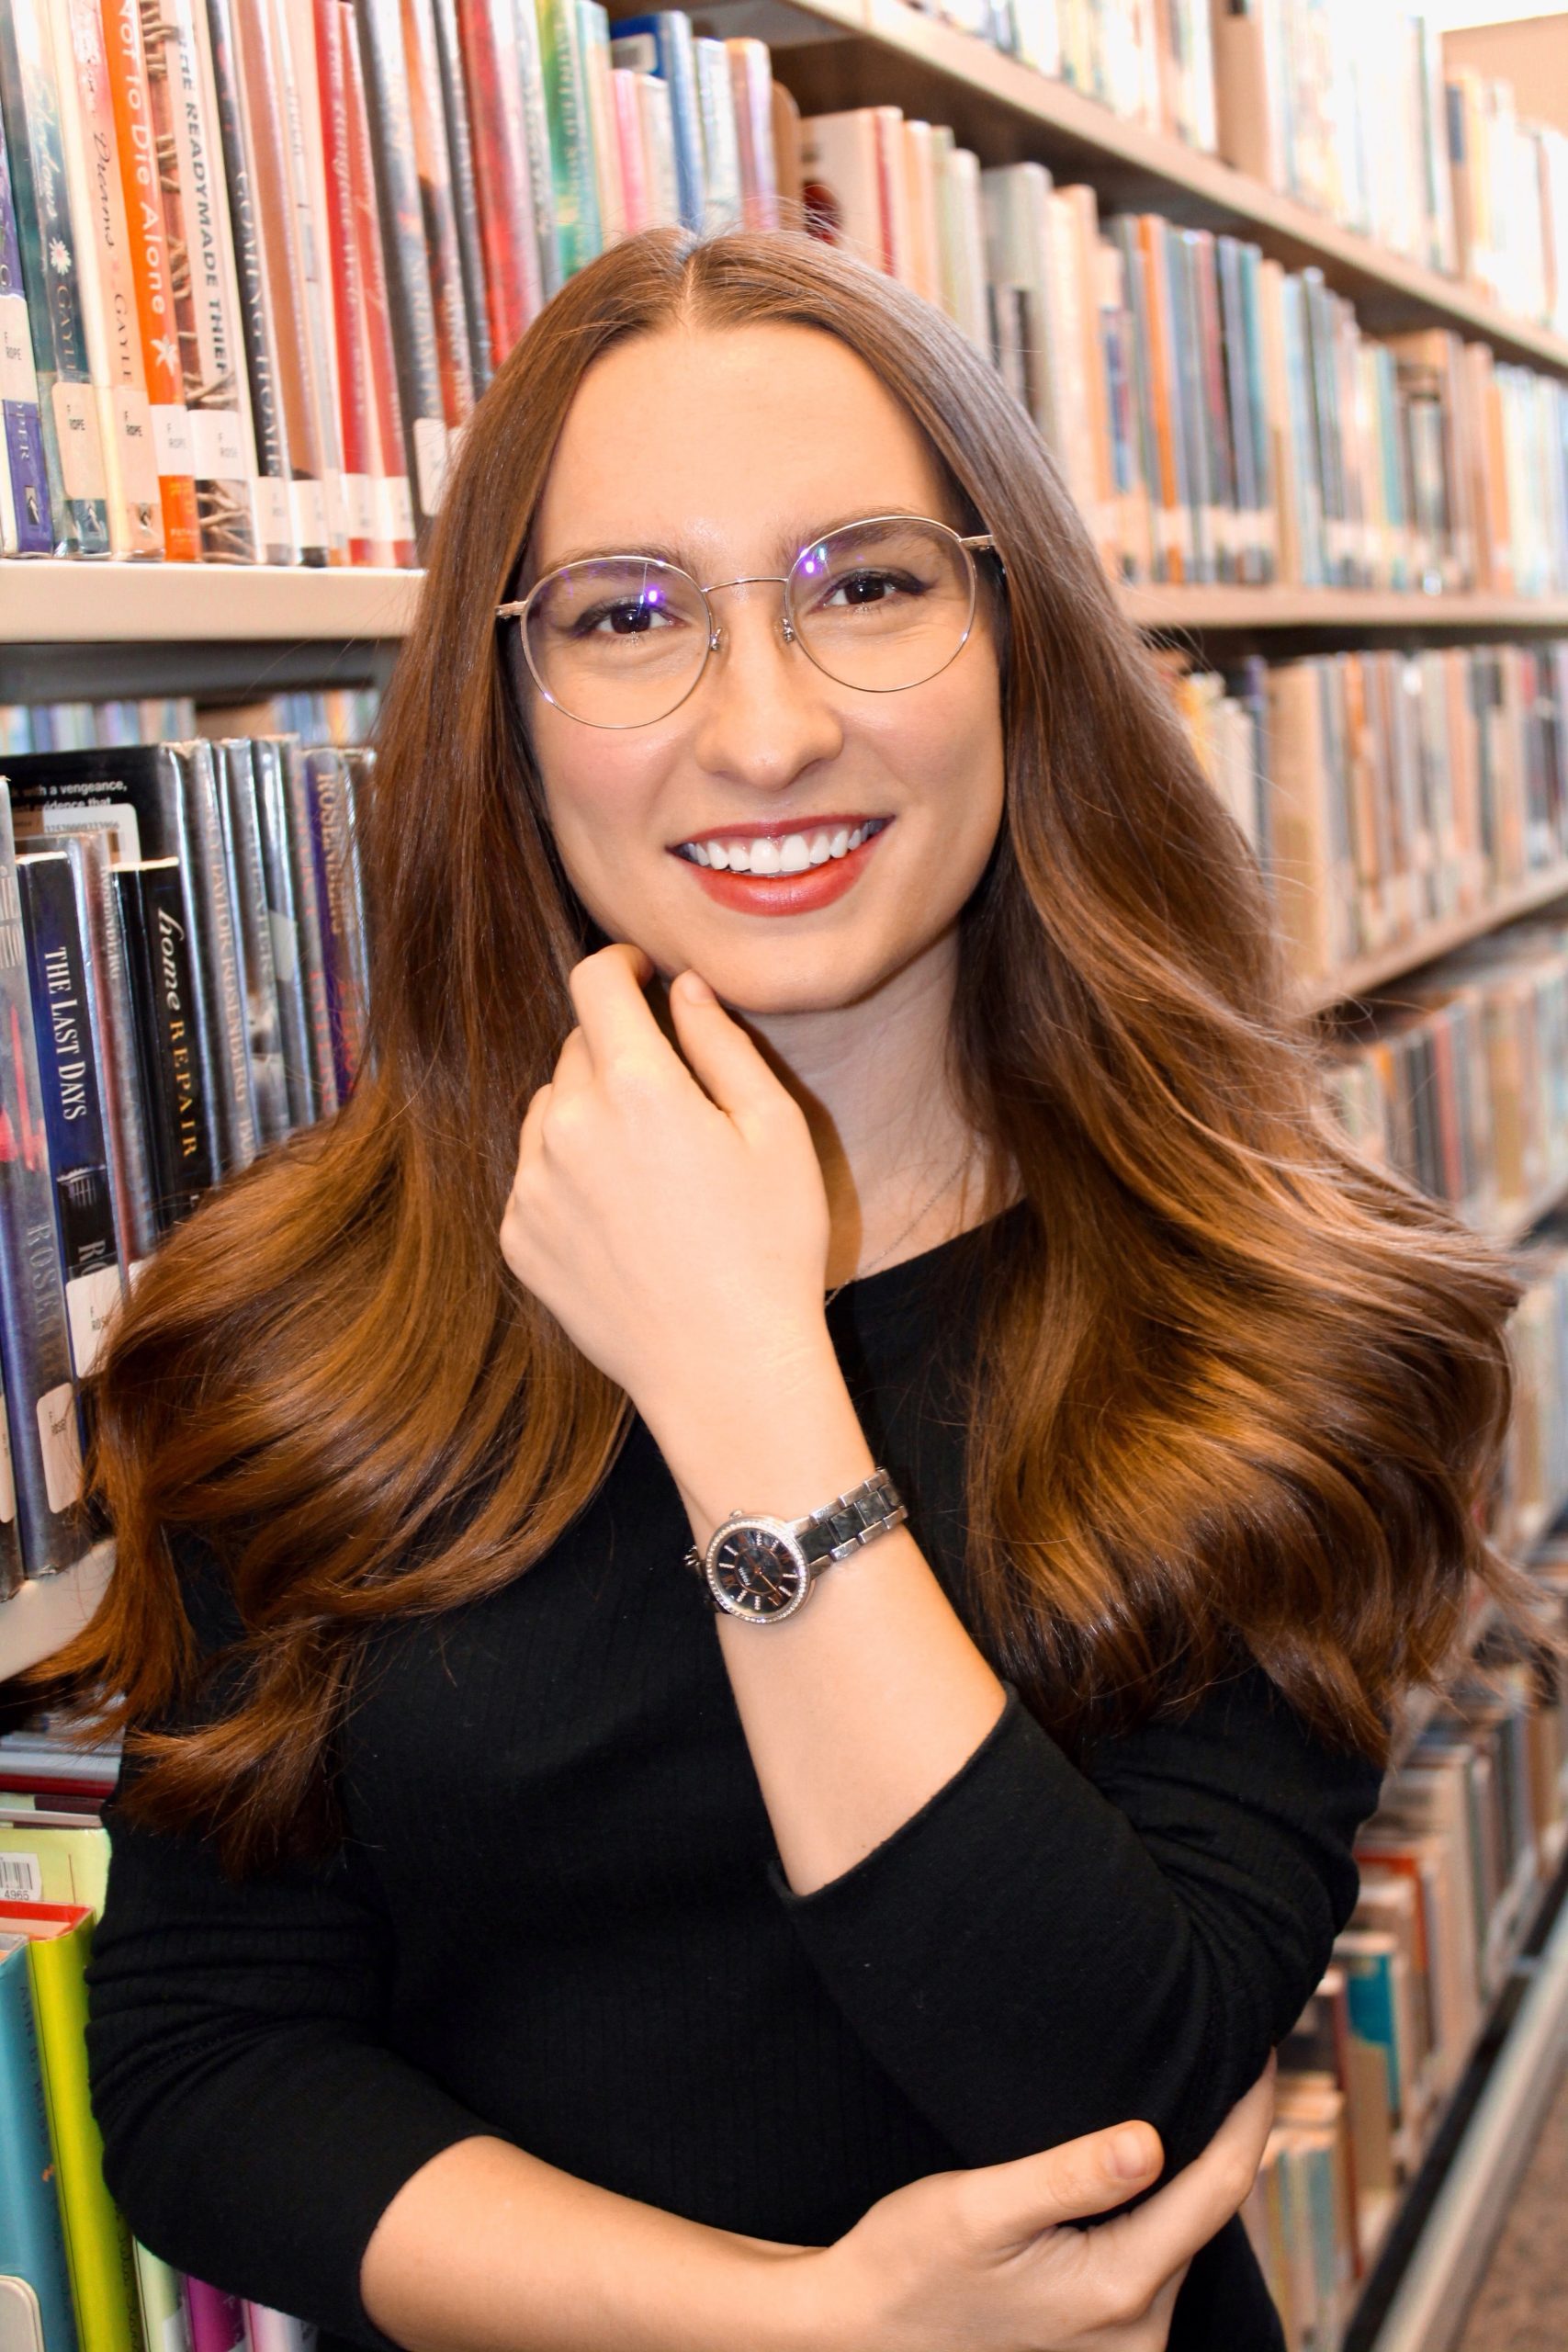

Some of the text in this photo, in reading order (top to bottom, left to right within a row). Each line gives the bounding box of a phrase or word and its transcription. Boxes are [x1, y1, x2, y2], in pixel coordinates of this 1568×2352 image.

[126, 74, 143, 109] to
[94, 131, 115, 247] Dreams
[131, 122, 154, 187] Die
[186, 102, 219, 288] READYMADE
[140, 200, 166, 315] Alone
[114, 293, 133, 383] GAYLE
[17, 401, 30, 460] PER
[50, 786, 57, 796] a
[60, 780, 128, 796] vengeance,
[211, 863, 232, 950] TAYLOR
[44, 946, 87, 1121] THE LAST DAYS
[158, 907, 198, 1157] home REPAIR
[221, 957, 247, 1102] ROSENBERG
[738, 1566, 752, 1587] FOSSIL
[5, 1889, 29, 1901] 4965
